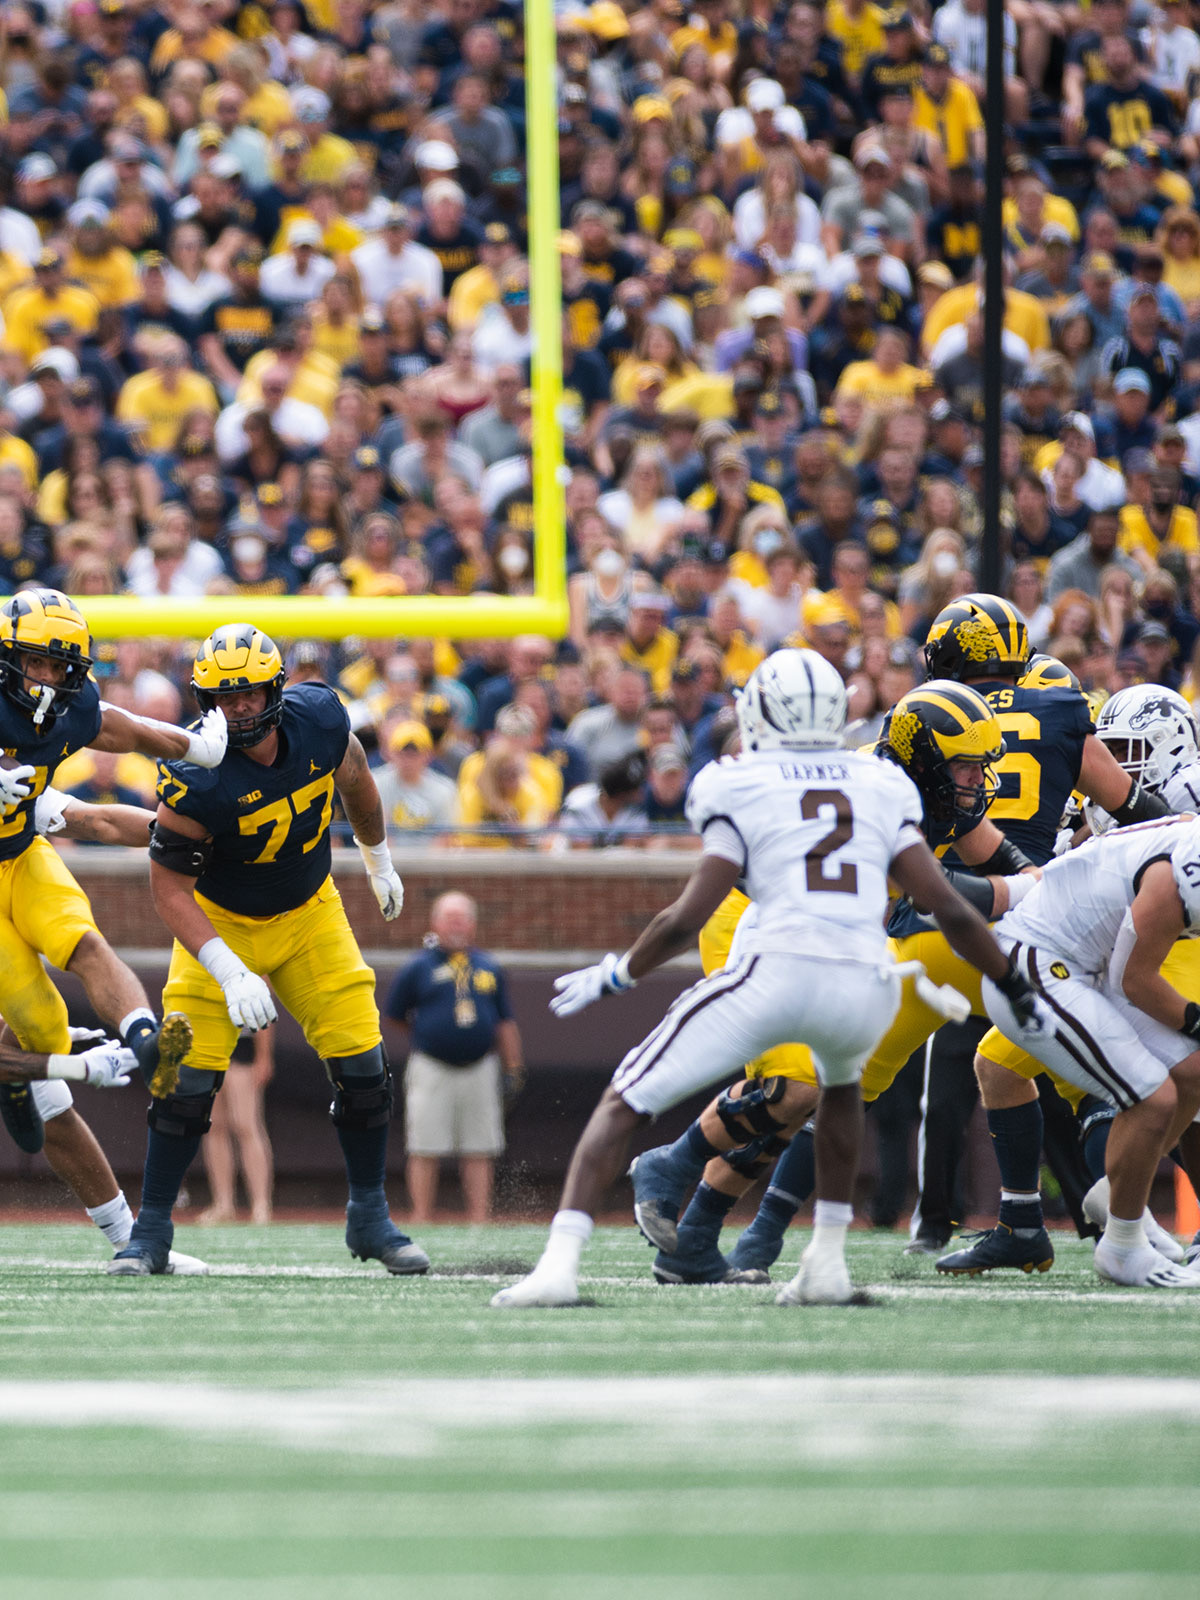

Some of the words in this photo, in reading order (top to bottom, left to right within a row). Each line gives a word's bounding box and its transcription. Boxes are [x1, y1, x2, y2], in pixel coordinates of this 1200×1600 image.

[237, 768, 335, 865] 77
[983, 712, 1041, 820] 6
[800, 789, 859, 895] 2
[1052, 964, 1068, 979] W
